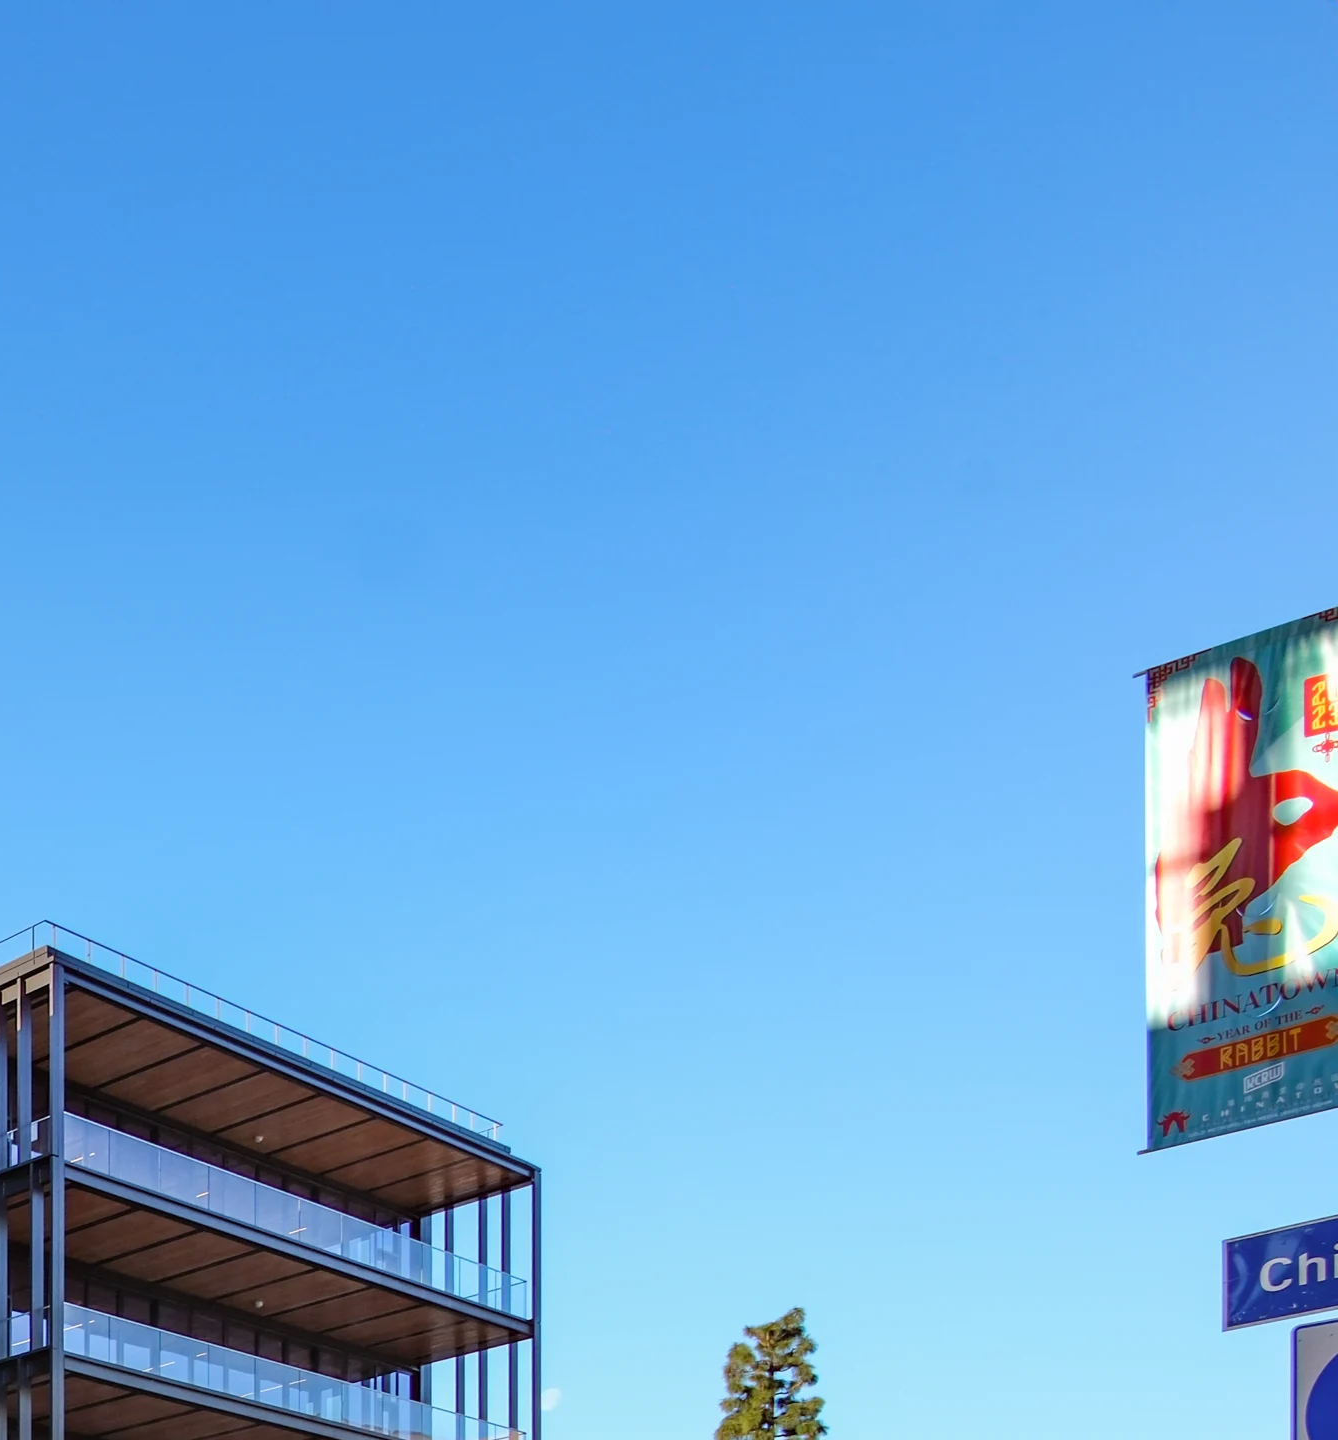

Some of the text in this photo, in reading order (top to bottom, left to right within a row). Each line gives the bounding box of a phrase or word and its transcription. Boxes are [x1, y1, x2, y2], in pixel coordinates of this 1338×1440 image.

[1167, 967, 1338, 1032] CHINATOW
[1217, 1009, 1303, 1041] YEAR OF THE
[1219, 1027, 1302, 1070] RABBIT
[1246, 1065, 1282, 1090] KCRW
